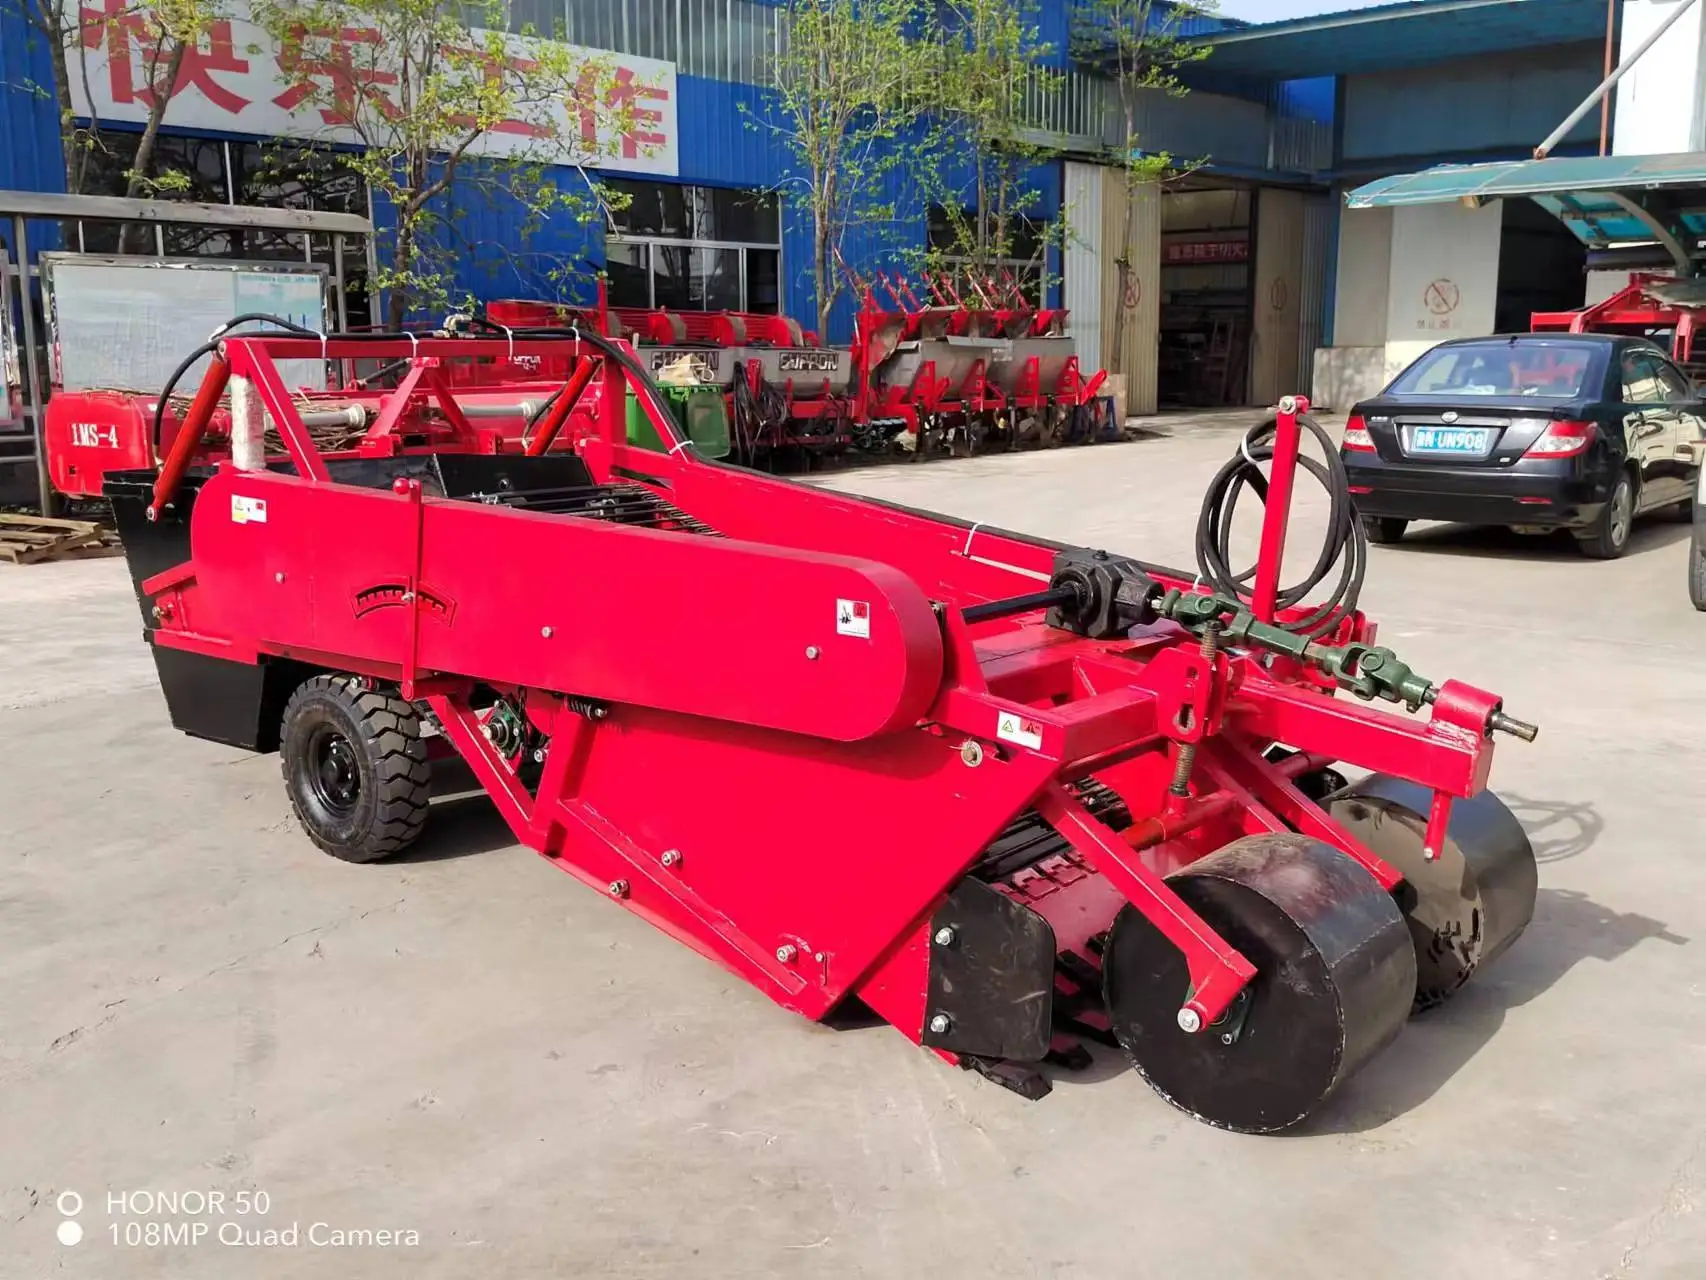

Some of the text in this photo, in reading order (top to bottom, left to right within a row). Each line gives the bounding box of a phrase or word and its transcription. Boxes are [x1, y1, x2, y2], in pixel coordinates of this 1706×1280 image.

[79, 0, 669, 160] 快乐工作
[71, 423, 118, 448] 1MS-4
